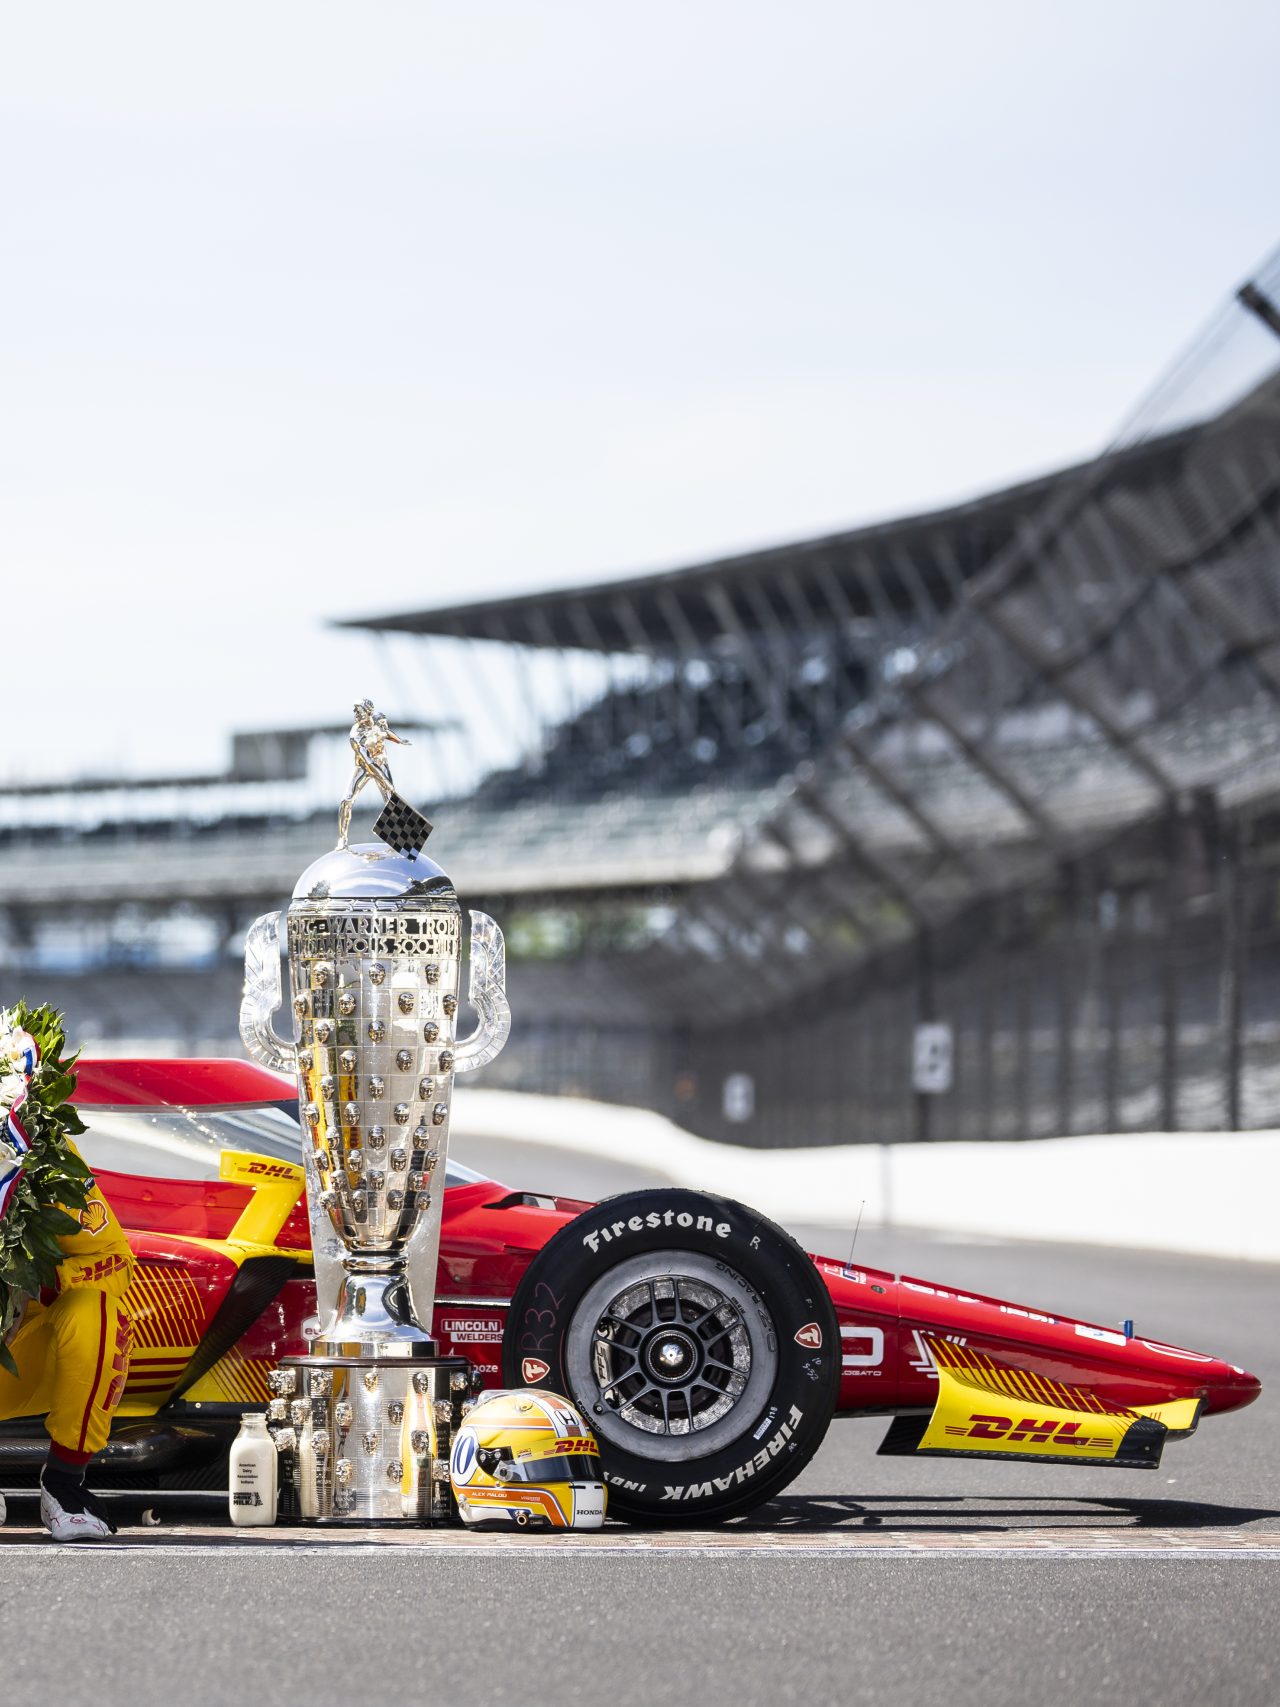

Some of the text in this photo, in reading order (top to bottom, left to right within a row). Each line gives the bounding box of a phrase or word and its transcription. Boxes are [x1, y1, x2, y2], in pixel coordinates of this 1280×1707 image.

[248, 1161, 296, 1180] DHL
[583, 1209, 732, 1255] Firestone
[444, 1321, 498, 1331] LINCOLN
[456, 1333, 503, 1341] WELDERS
[965, 1414, 1084, 1447] DHL
[452, 1434, 475, 1475] 10
[554, 1439, 600, 1454] DHL
[659, 1404, 804, 1500] FIREHAWK
